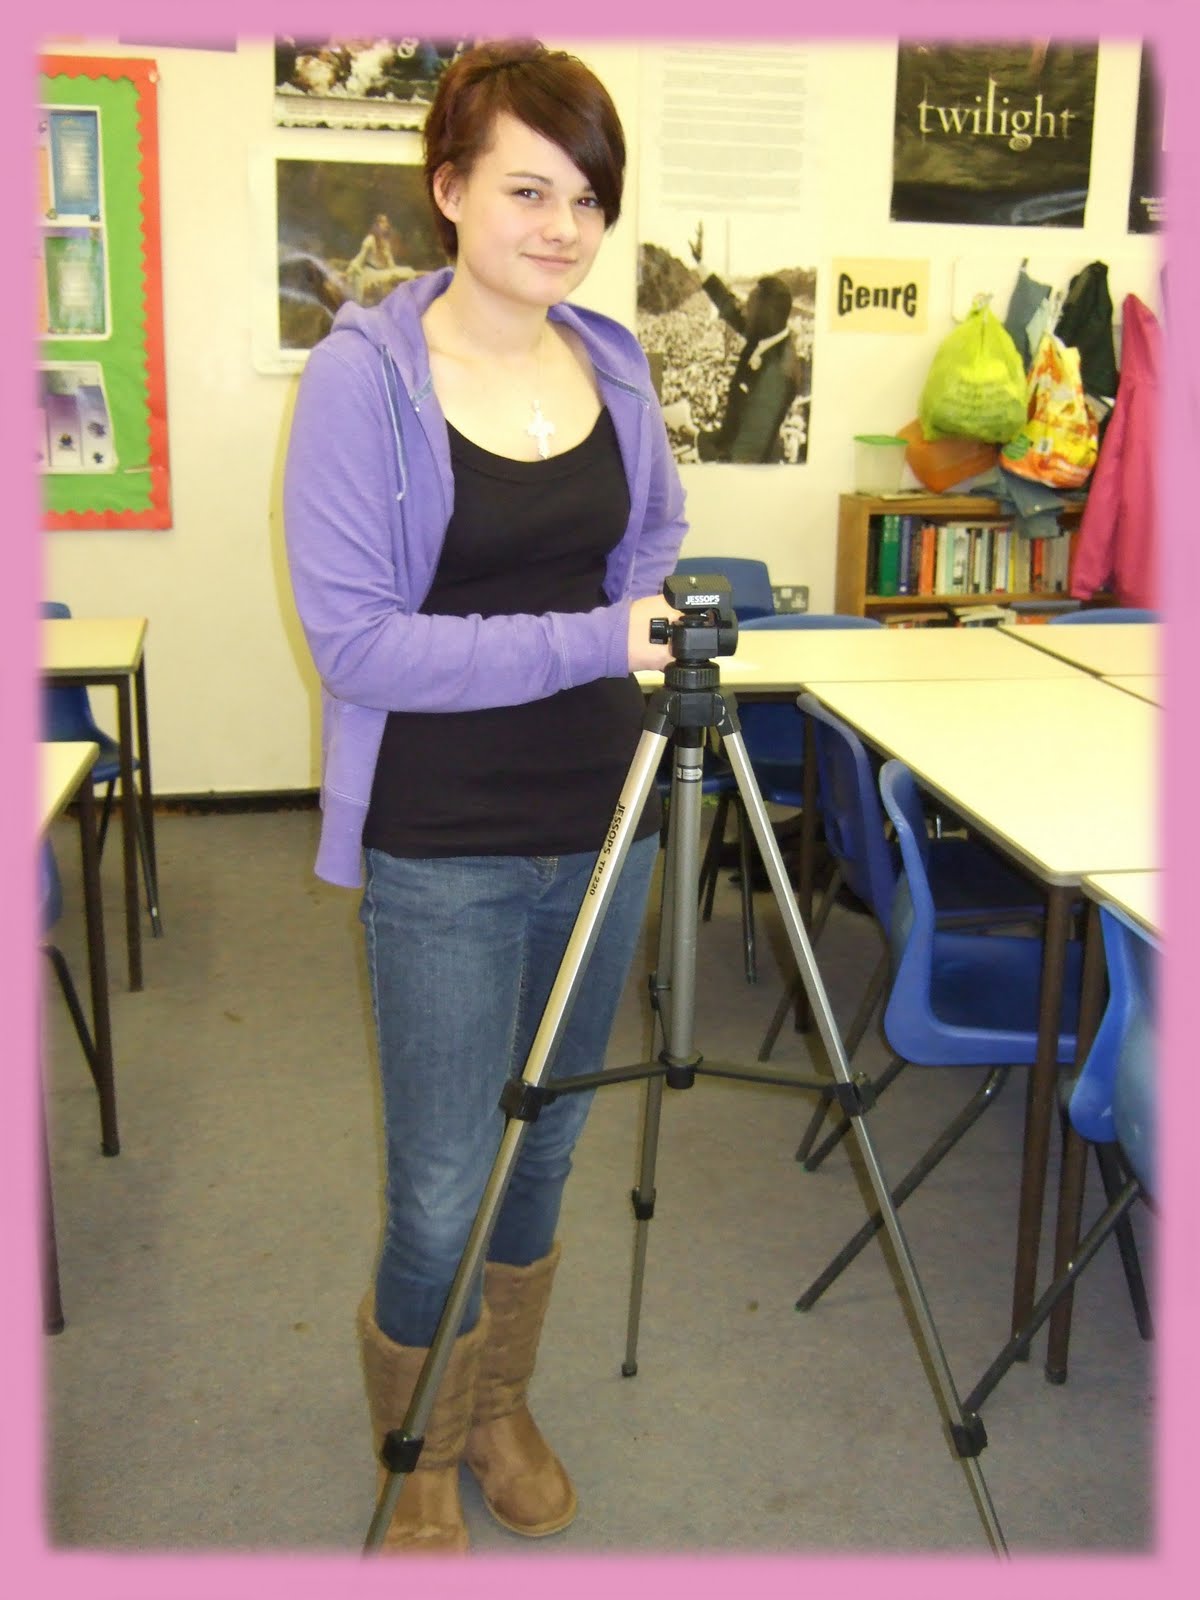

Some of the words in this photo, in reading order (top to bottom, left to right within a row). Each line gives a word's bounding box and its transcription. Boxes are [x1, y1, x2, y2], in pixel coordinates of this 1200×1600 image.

[917, 76, 1076, 151] twilight
[838, 272, 917, 318] Genre
[685, 594, 720, 605] JESSOPS
[603, 803, 626, 855] JESSOPS
[598, 860, 606, 874] TP
[589, 875, 601, 896] 220
